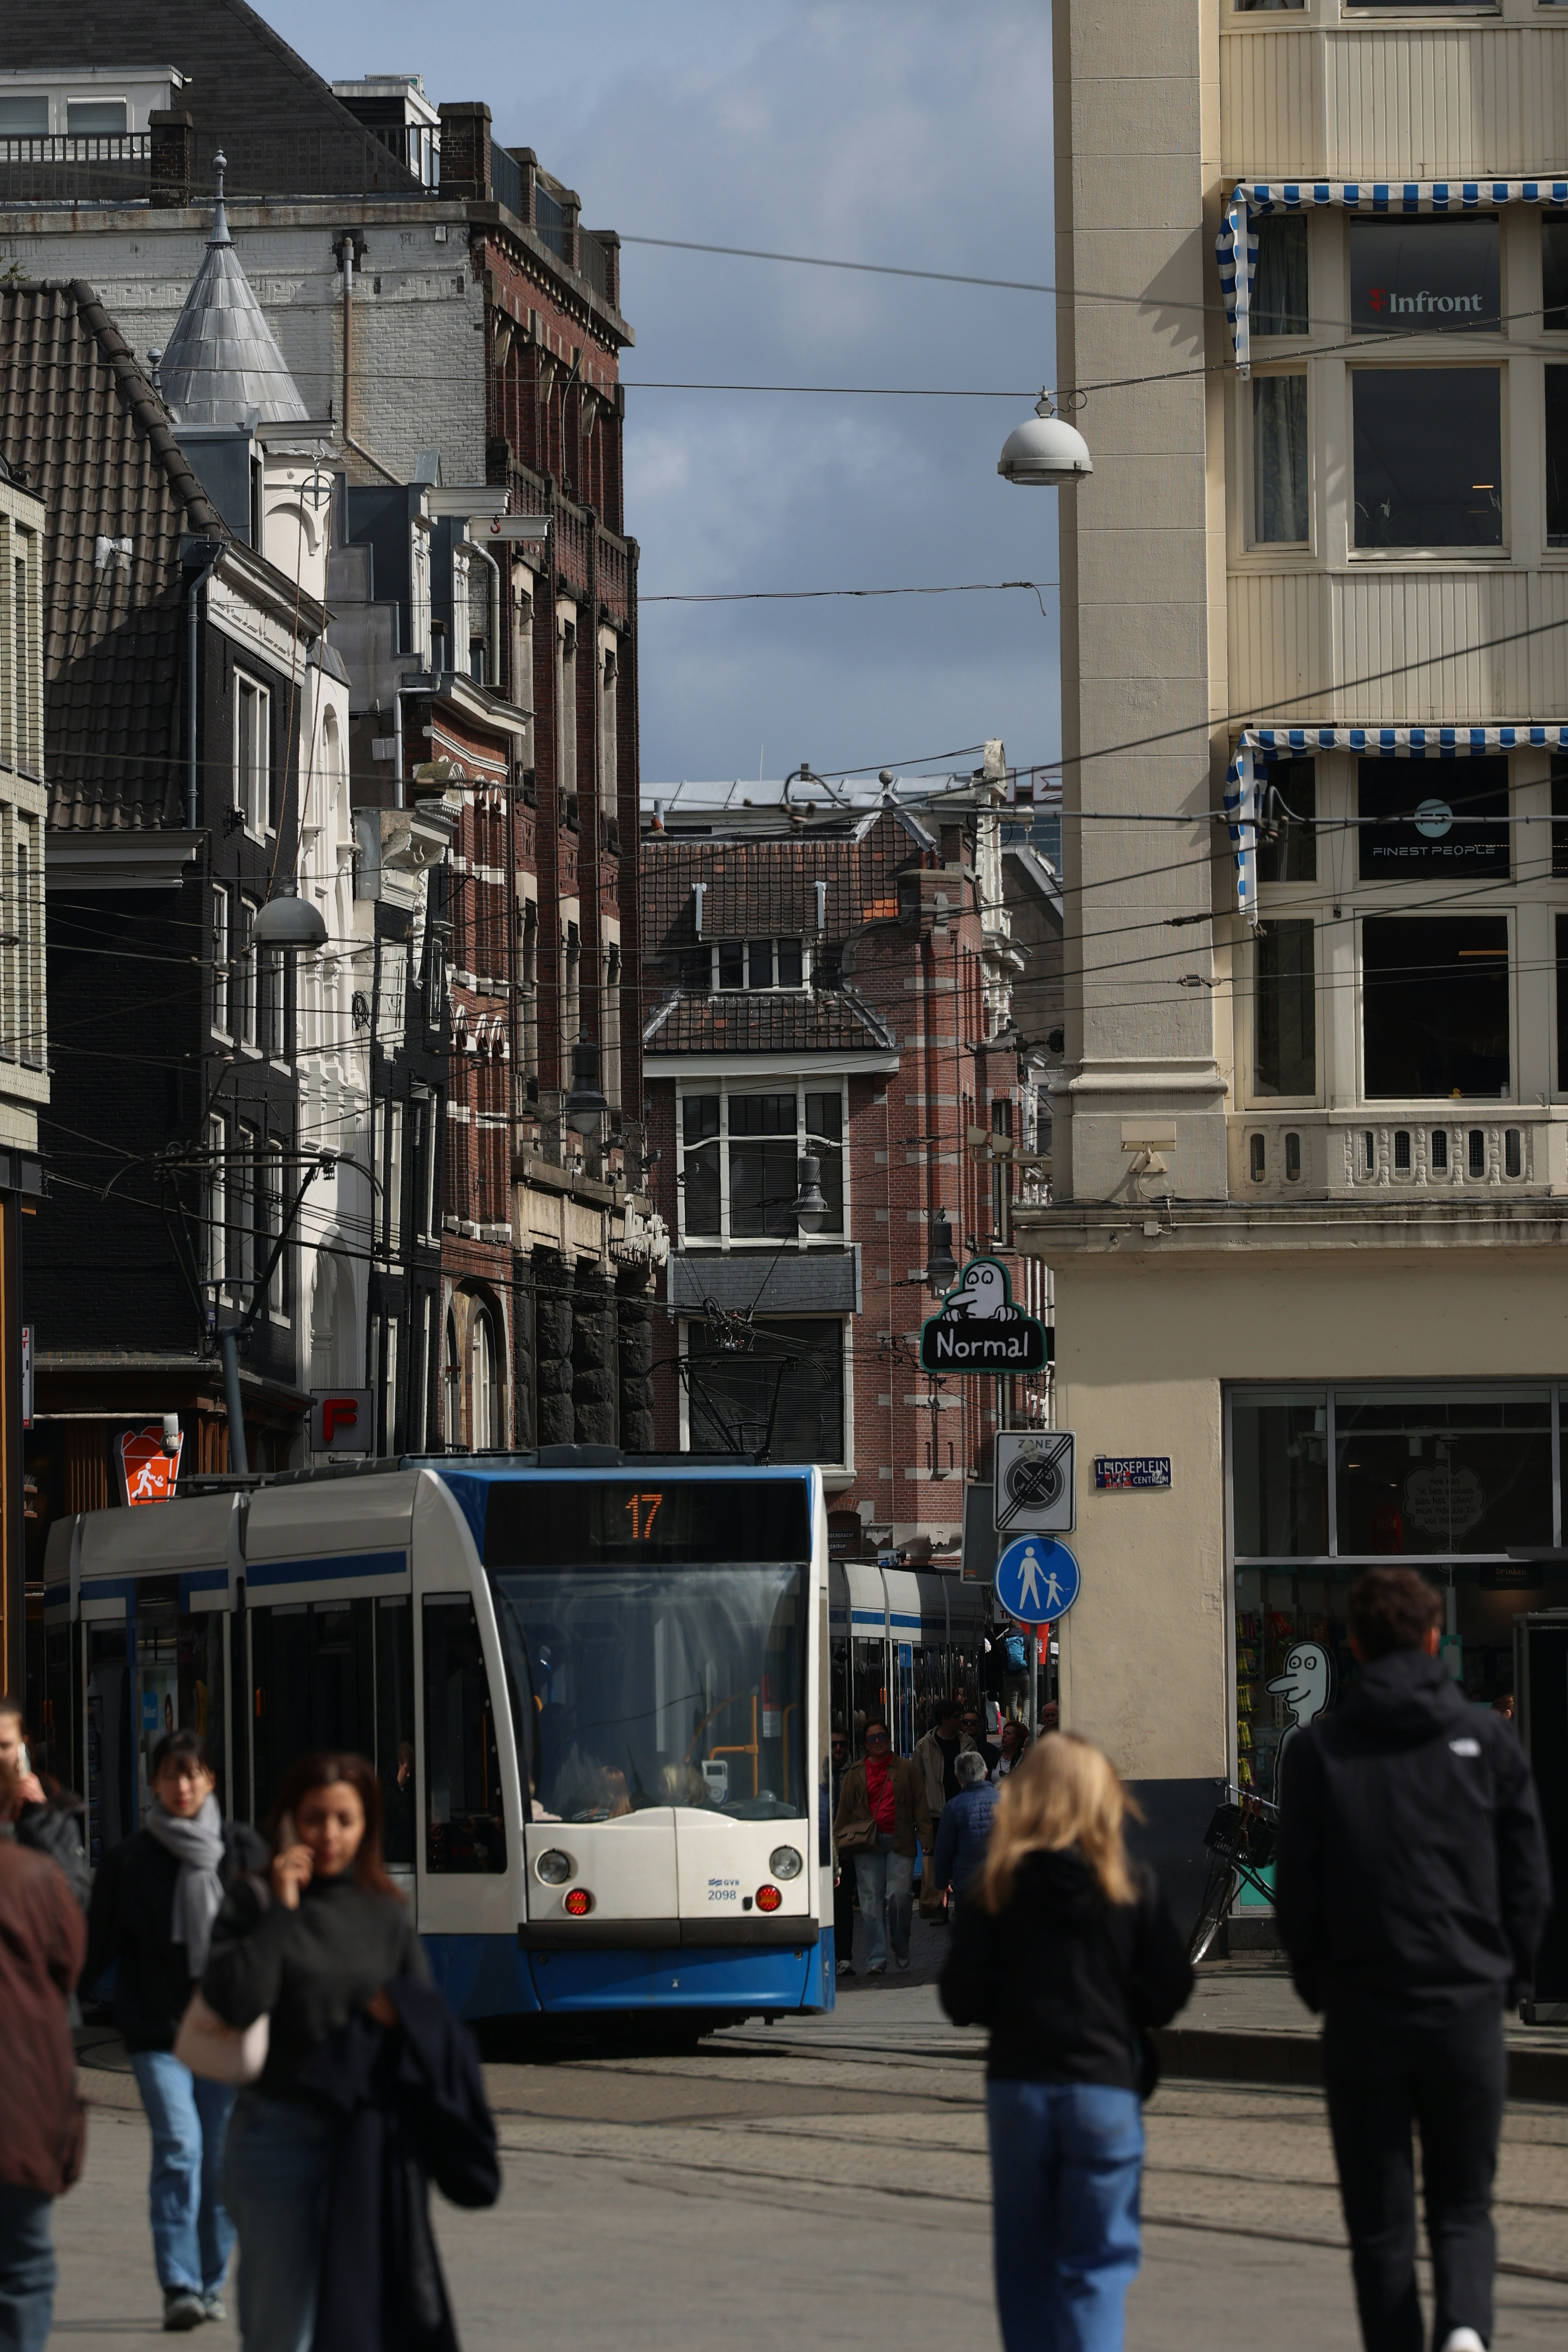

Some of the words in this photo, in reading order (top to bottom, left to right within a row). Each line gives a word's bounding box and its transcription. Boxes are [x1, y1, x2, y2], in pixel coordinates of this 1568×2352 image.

[1389, 291, 1482, 313] Infront
[1373, 847, 1427, 856] FINEST
[1432, 845, 1495, 856] PEOPLE
[937, 1328, 1029, 1358] Normal
[323, 1398, 360, 1443] F
[1018, 1439, 1052, 1449] ZNE
[625, 1494, 662, 1539] 17
[708, 1890, 736, 1900] 2098
